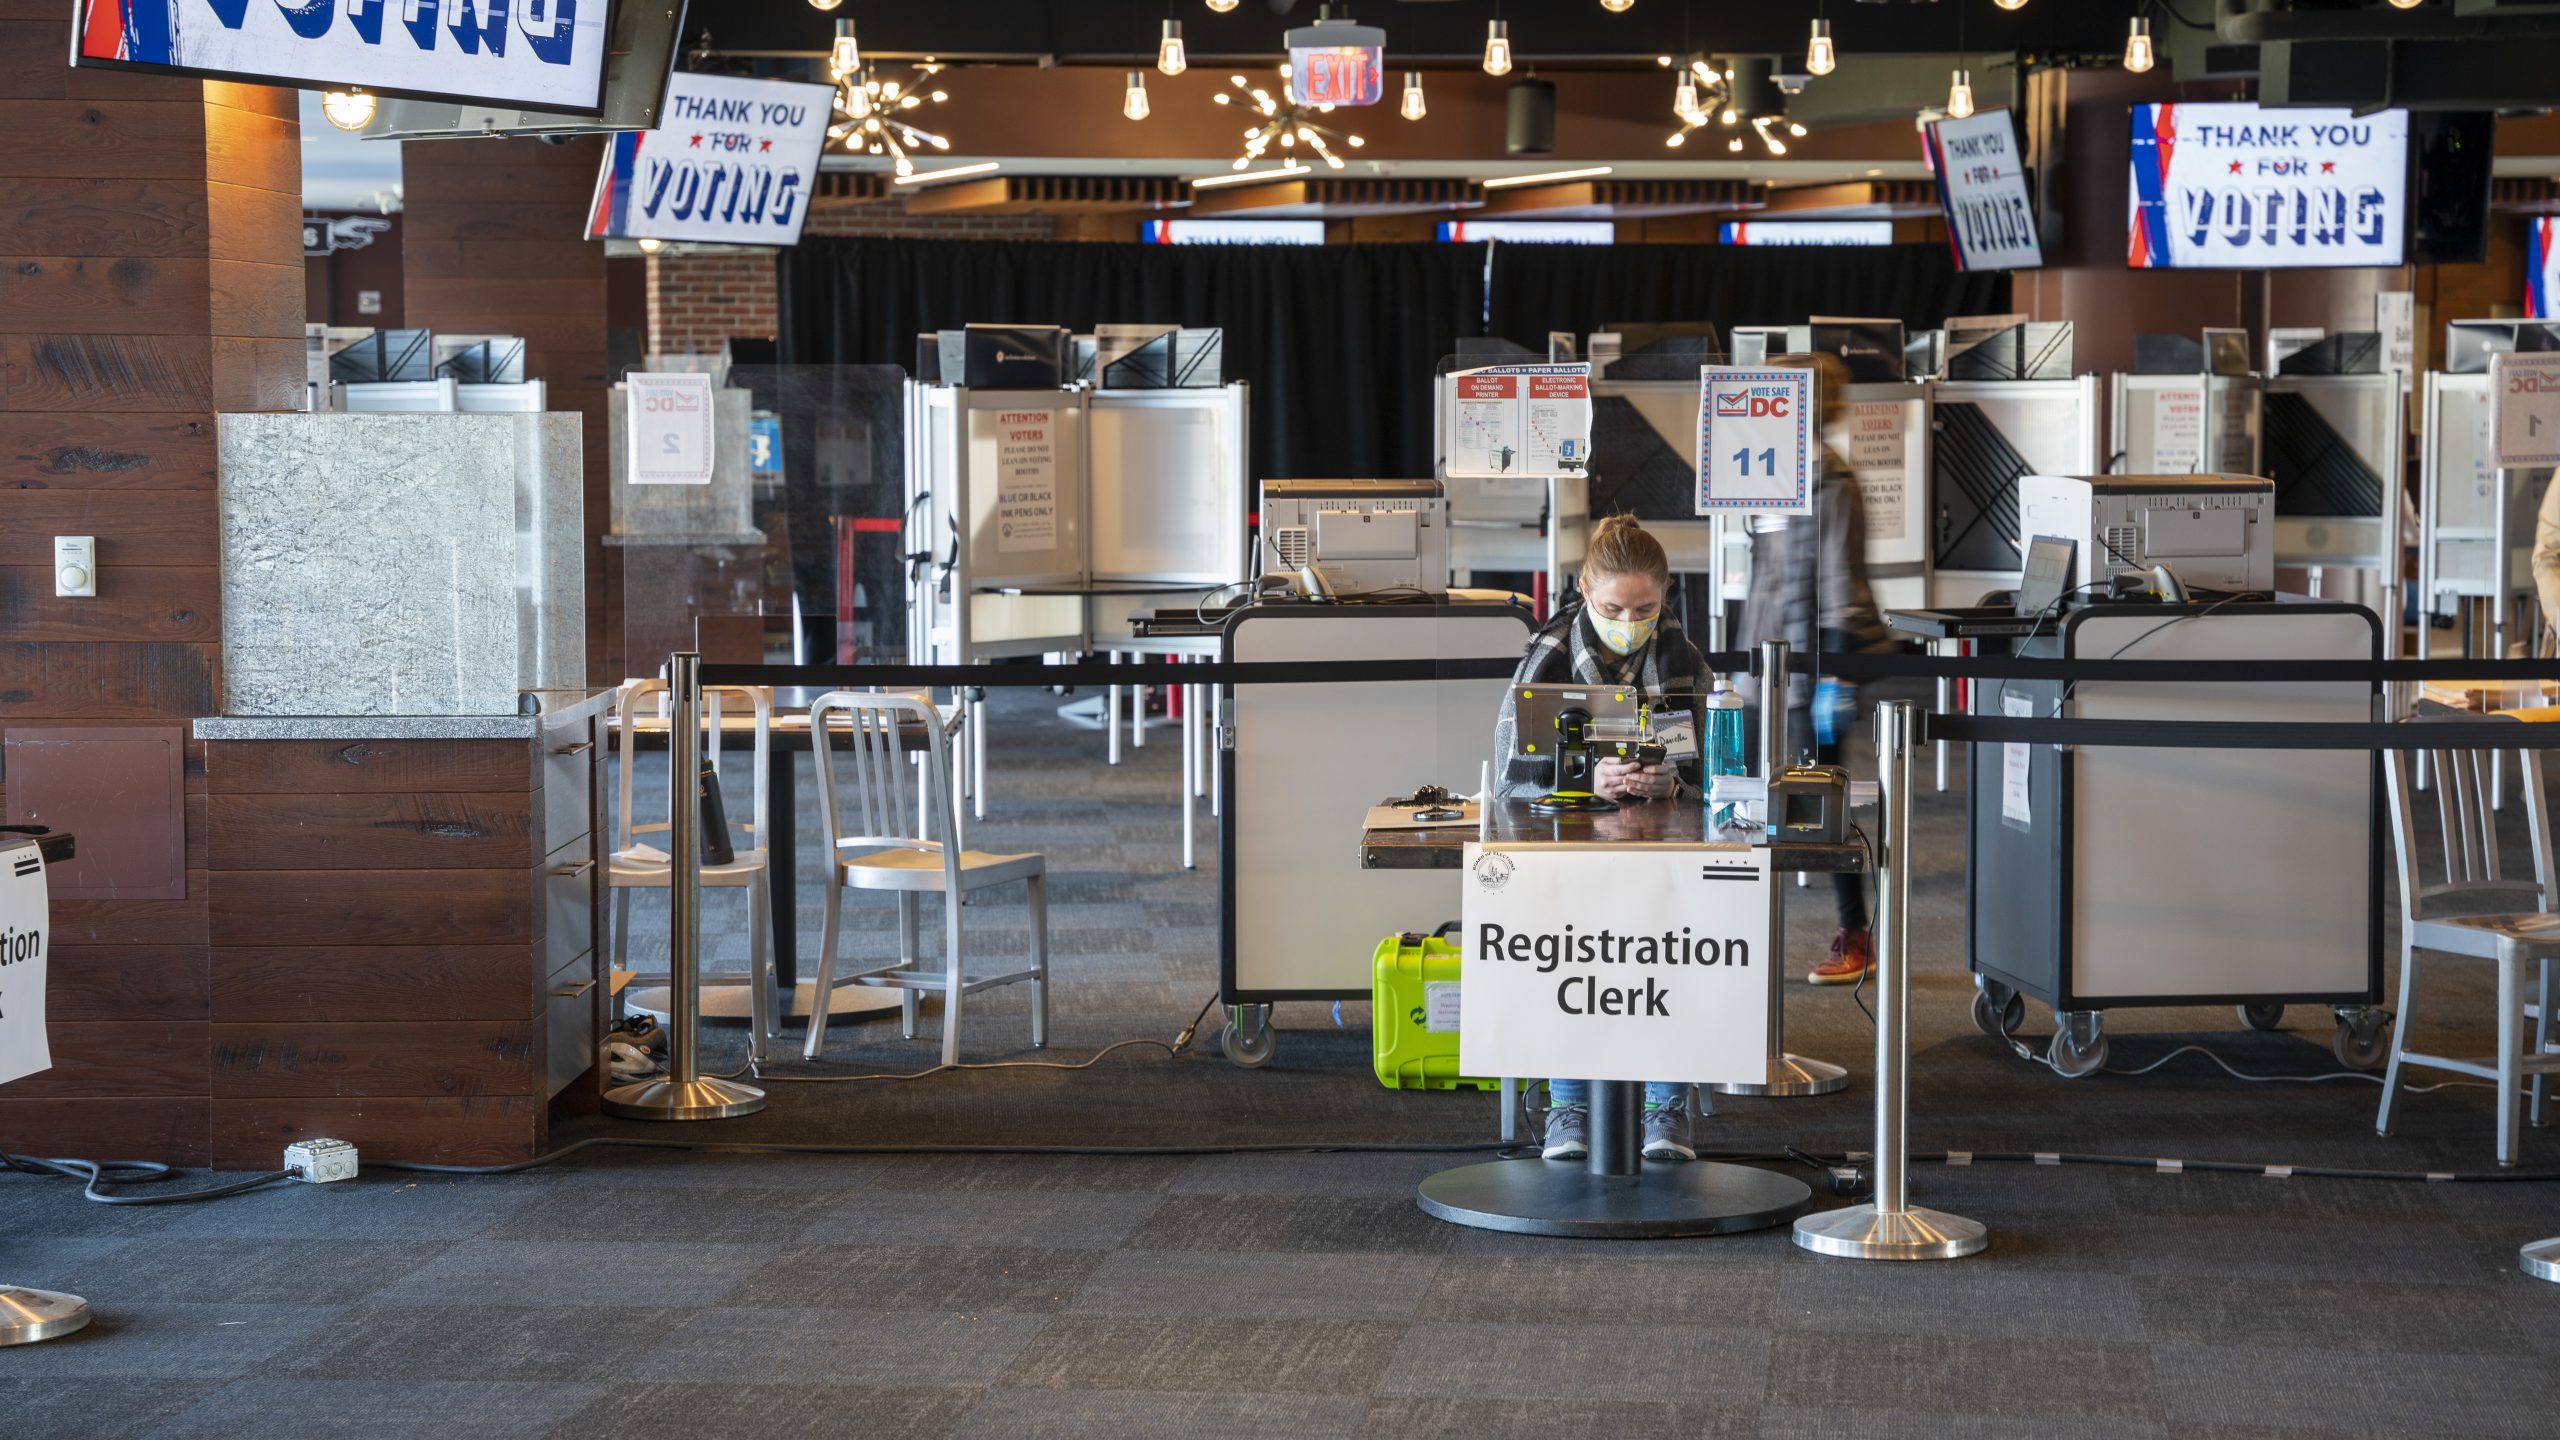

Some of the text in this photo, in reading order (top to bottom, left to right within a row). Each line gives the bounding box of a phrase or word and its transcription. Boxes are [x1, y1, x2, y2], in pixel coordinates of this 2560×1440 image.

[1307, 53, 1369, 101] EXIT
[674, 95, 806, 127] THANK YOU
[710, 132, 752, 153] FOR
[1947, 132, 2005, 160] THANK YOU
[2197, 125, 2371, 148] THANK YOU
[2257, 157, 2308, 176] FOR
[643, 157, 800, 226] VOTING
[1955, 190, 2032, 253] VOTING
[2178, 185, 2385, 247] VOTING
[1751, 387, 1790, 396] VOTE SAFE
[1750, 396, 1790, 418] DC
[1855, 403, 1899, 416] ATTENTION
[1000, 412, 1048, 424] ATTENTION
[1862, 419, 1893, 431] VOTERS
[1010, 430, 1043, 442] VOTERS
[1732, 447, 1775, 477] 11
[999, 492, 1052, 503] BLUE OR BLACK
[1881, 484, 1903, 493] BLACK
[1884, 496, 1901, 504] ONLY
[1001, 507, 1053, 518] INK PENS ONLY
[1473, 855, 1484, 871] BOARD
[1493, 851, 1516, 871] ELECTIONS
[0, 926, 40, 967] tion
[1479, 922, 1750, 973] Registration
[1557, 976, 1670, 1017] Clerk
